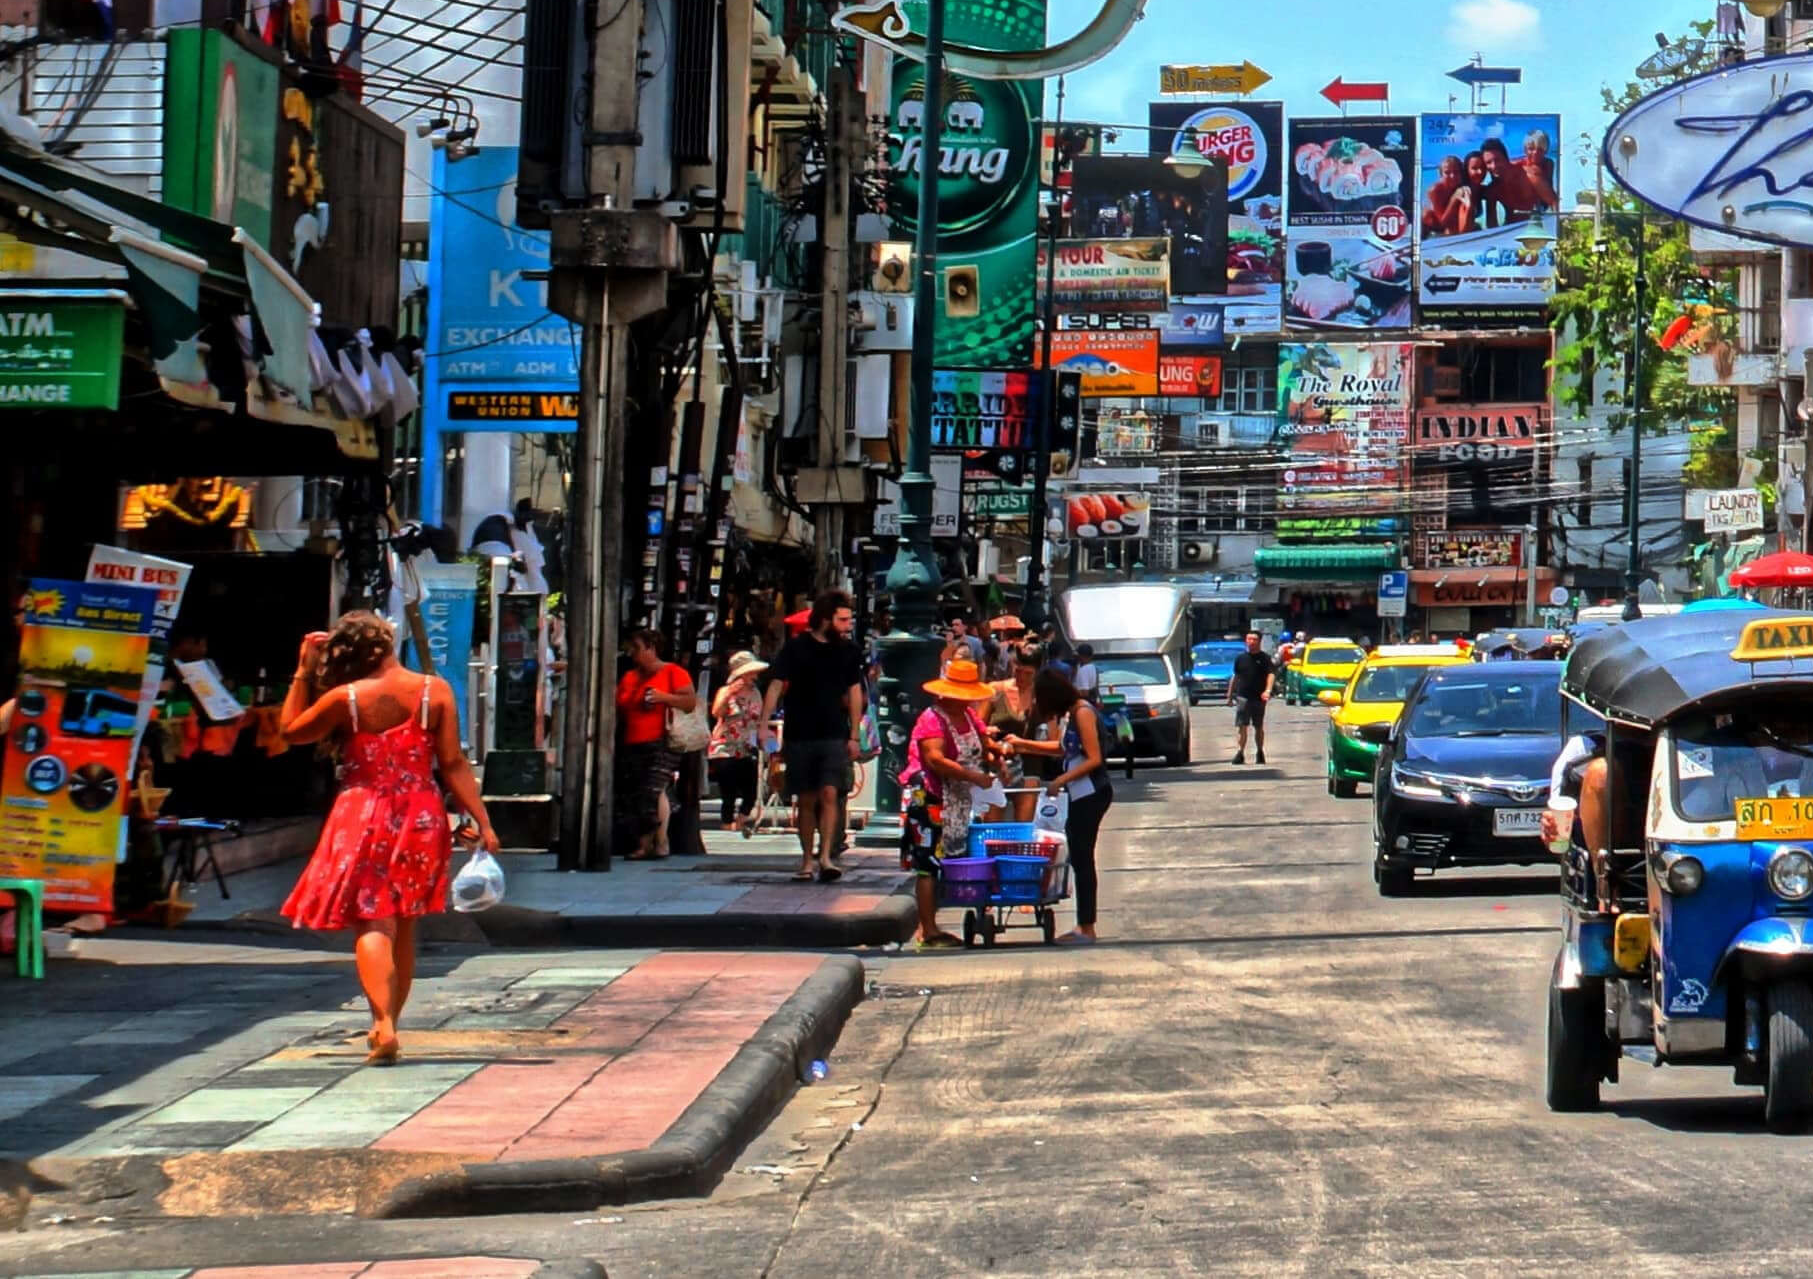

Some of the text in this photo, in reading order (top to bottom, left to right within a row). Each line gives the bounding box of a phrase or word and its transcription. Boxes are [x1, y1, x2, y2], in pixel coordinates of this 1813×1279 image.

[1198, 125, 1253, 154] URGER
[1060, 246, 1105, 264] TOUR
[0, 313, 56, 337] ATM
[446, 362, 557, 374] ATM ADM
[0, 384, 72, 403] HANGE
[1298, 373, 1402, 397] The Royal
[453, 395, 531, 406] WESTERN
[476, 406, 531, 417] UNION
[1421, 415, 1532, 439] INDIAN
[93, 563, 179, 584] MINI BUS
[1382, 574, 1394, 589] P
